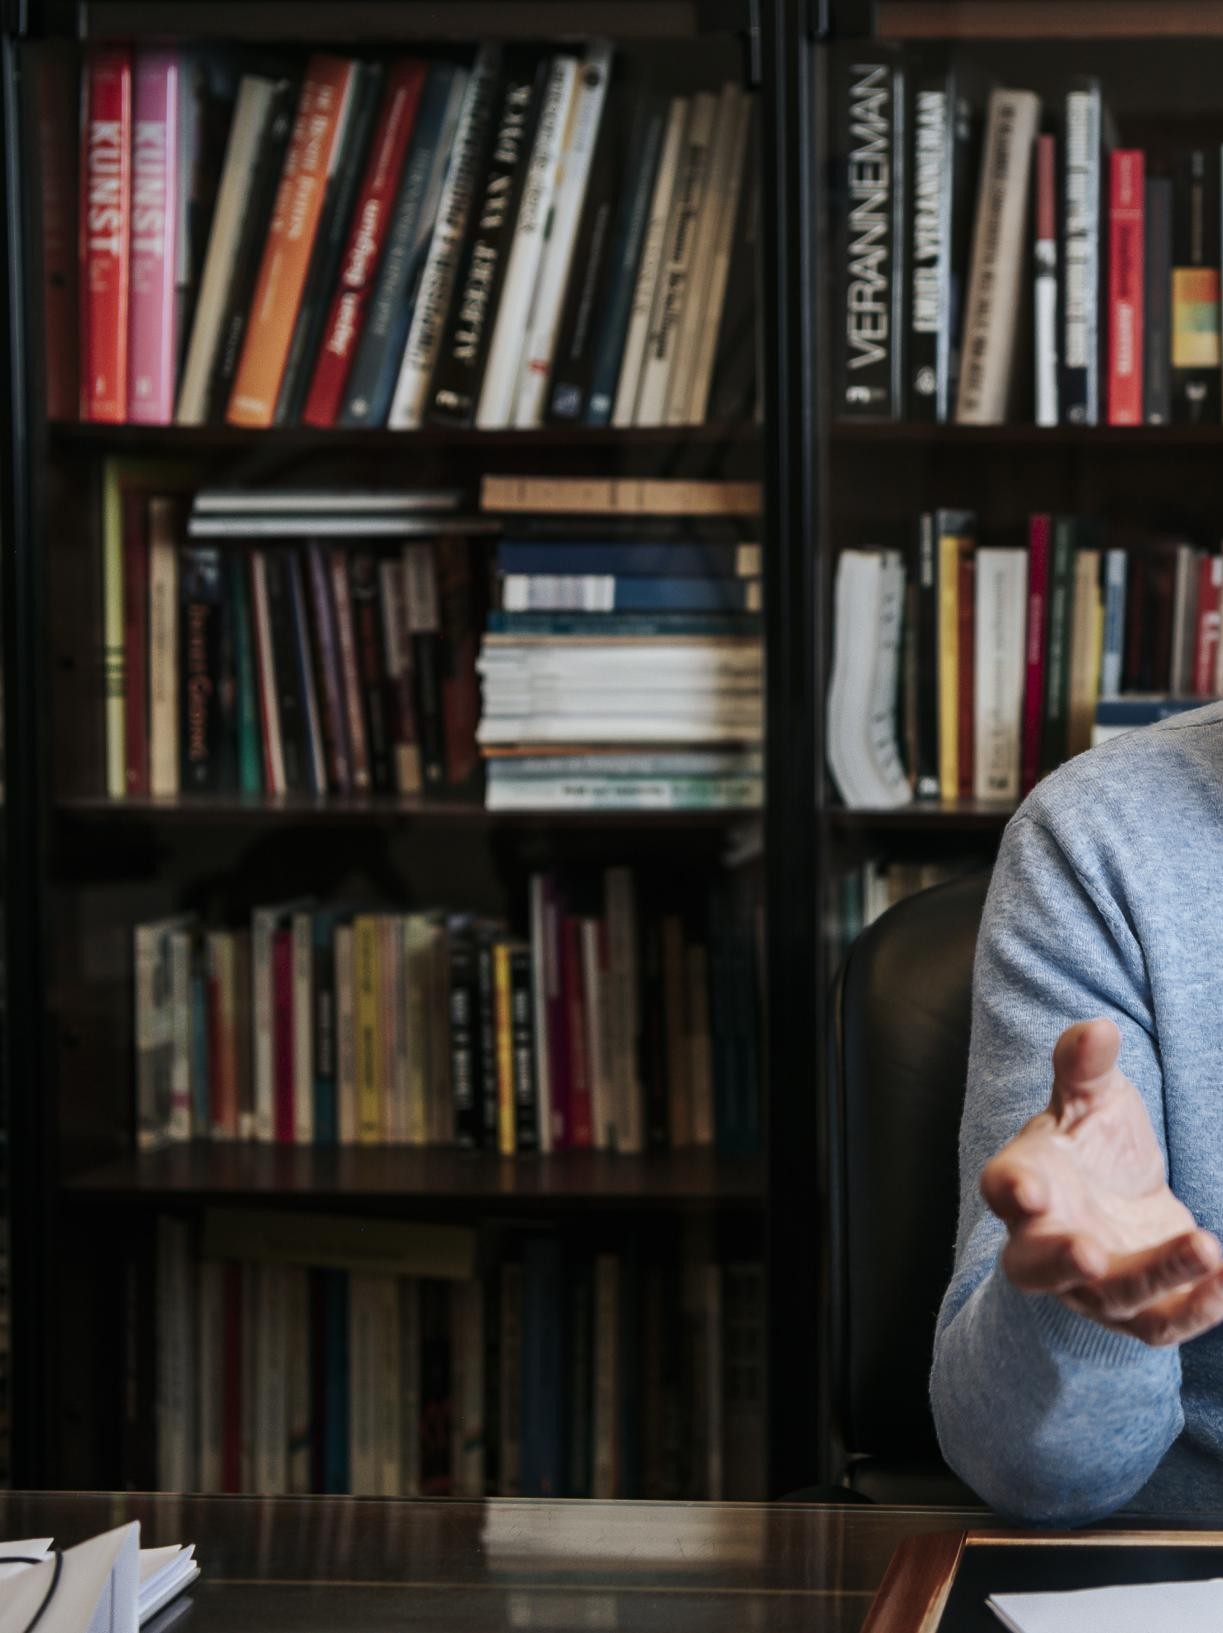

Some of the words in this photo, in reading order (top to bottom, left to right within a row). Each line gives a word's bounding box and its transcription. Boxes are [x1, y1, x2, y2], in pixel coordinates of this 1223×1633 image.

[88, 120, 123, 258] KUNST
[132, 120, 165, 259] KUNST
[847, 63, 890, 370] VERANNEMAN
